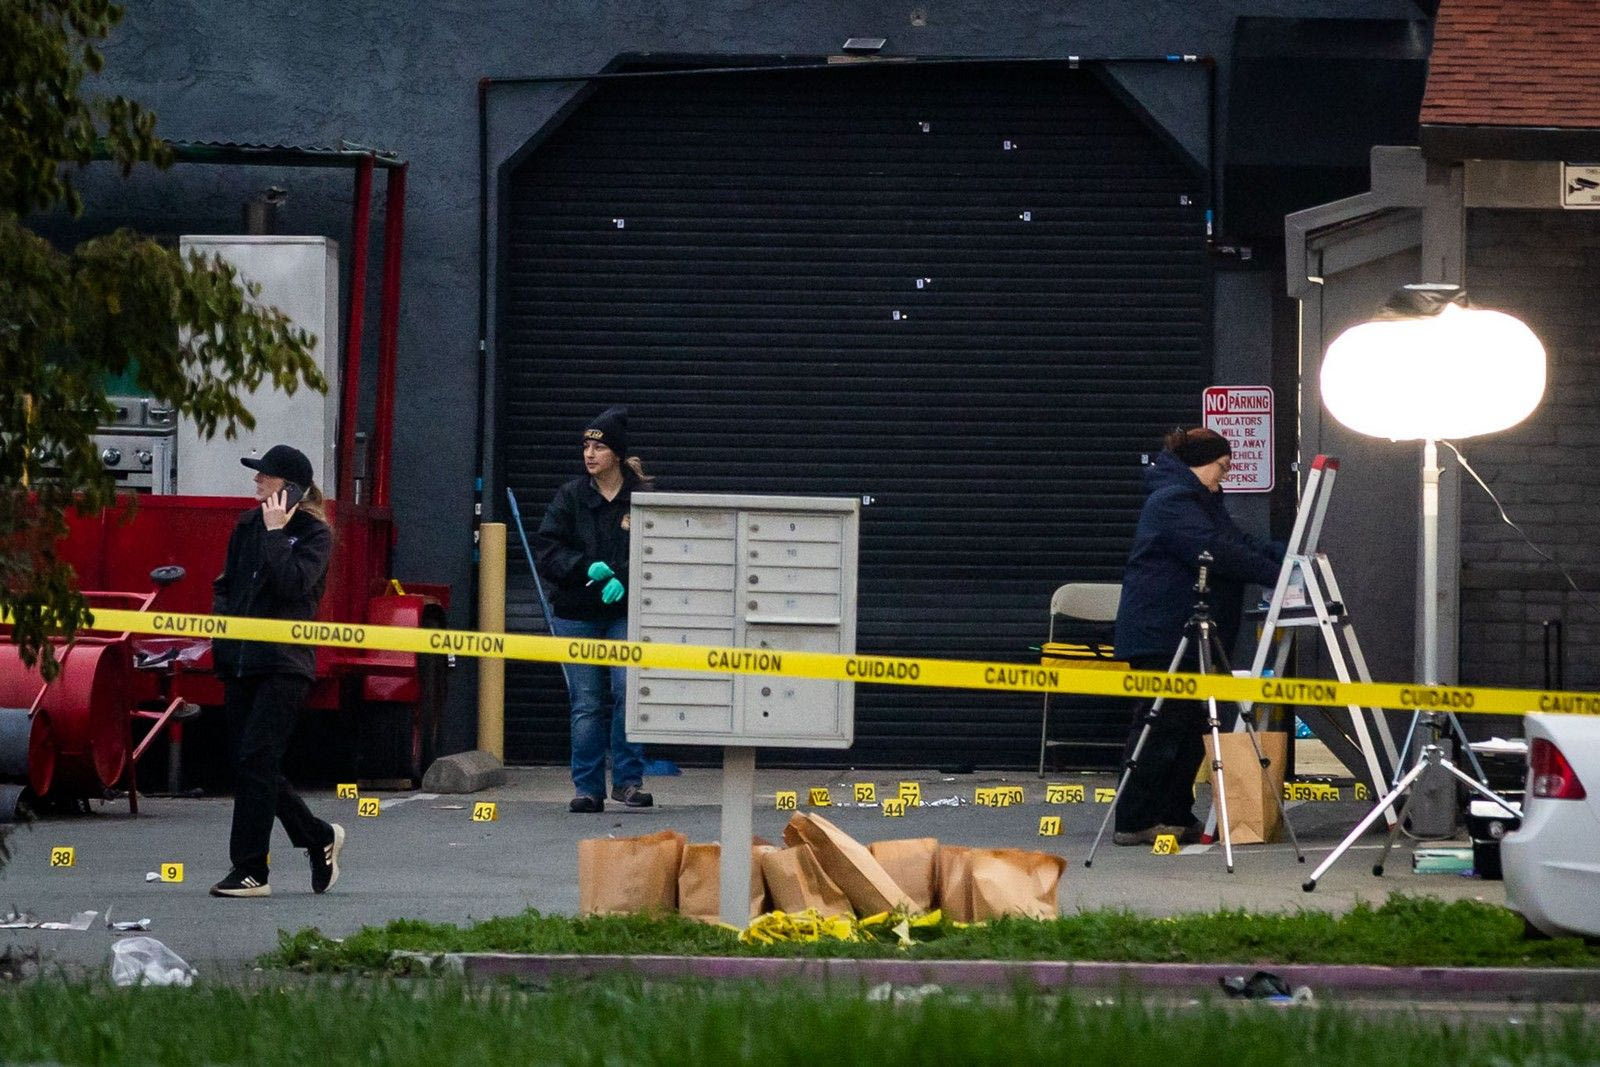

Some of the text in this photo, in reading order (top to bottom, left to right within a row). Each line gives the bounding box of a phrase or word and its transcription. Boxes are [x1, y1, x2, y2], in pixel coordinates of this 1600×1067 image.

[1206, 393, 1269, 411] NO PARKING
[1215, 416, 1262, 426] VIOLATORS
[1221, 428, 1256, 437] WILL BE
[1242, 440, 1266, 448] AWAY
[1229, 463, 1258, 471] NER'S
[789, 522, 796, 531] 9
[153, 615, 1600, 713] CAUTION CUIDADO CAUTION CUIDADO CAUTION CUIDADO CAUTION CUIDADO CAUTION CUIDADO CAUTIO
[339, 788, 356, 800] 45
[856, 787, 873, 800] 52
[902, 793, 917, 806] 57
[991, 793, 1008, 806] 47
[1295, 787, 1311, 800] 59
[360, 802, 377, 815] 42
[778, 796, 795, 808] 46
[475, 807, 492, 820] 43
[885, 803, 903, 816] 44
[1040, 821, 1057, 834] 41
[1154, 839, 1170, 853] 36
[52, 851, 71, 866] 38
[167, 866, 177, 879] 9
